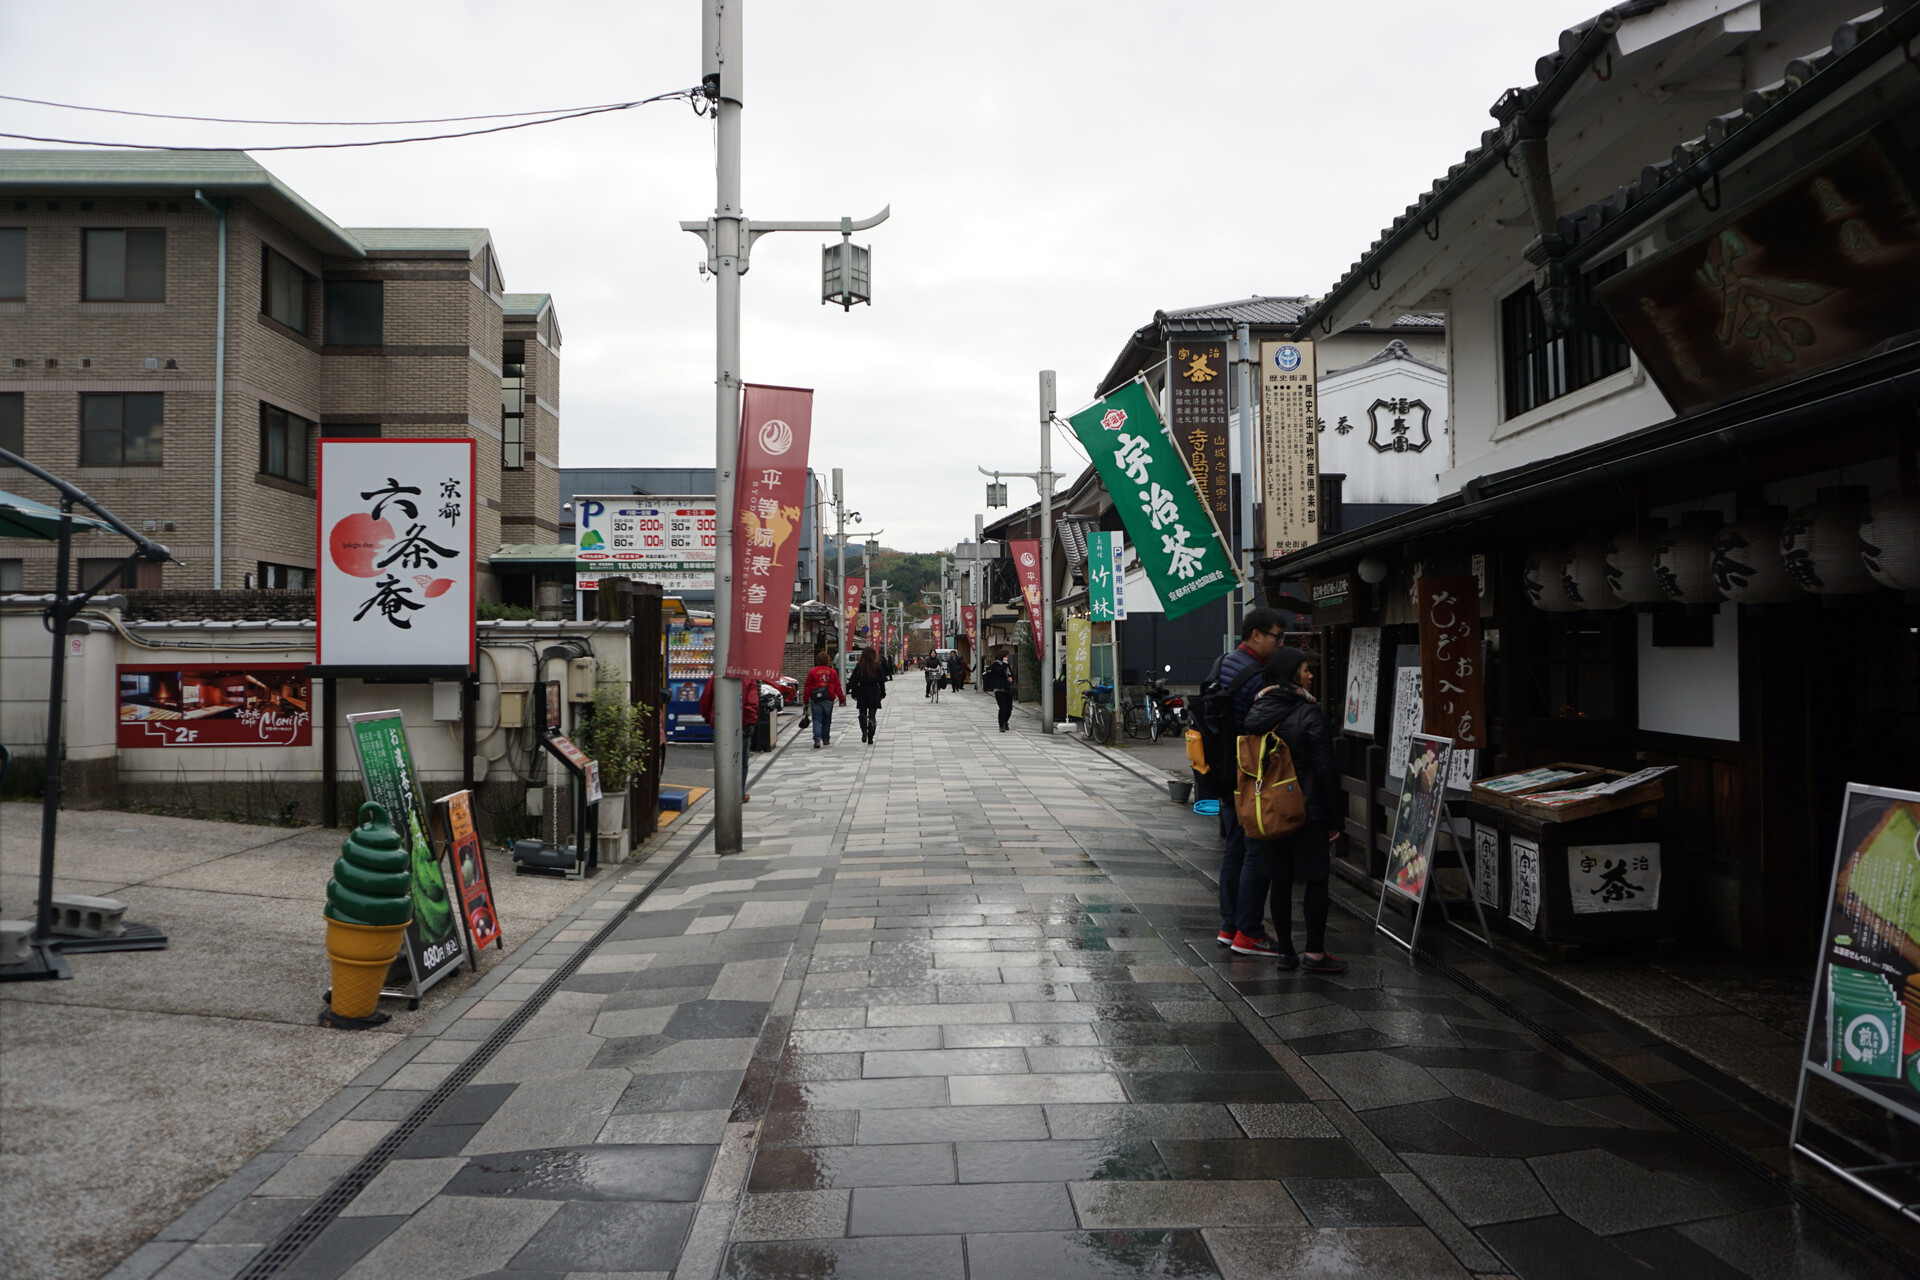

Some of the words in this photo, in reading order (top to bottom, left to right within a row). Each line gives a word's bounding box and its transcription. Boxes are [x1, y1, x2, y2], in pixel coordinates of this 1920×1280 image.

[1269, 374, 1308, 382] 歴史街道
[438, 478, 461, 527] 京都
[580, 500, 605, 528] P
[1113, 433, 1207, 580] 宇治茶
[353, 478, 460, 629] 六条庵
[744, 469, 783, 634] 平等院表参道
[1114, 547, 1122, 557] P
[1091, 564, 1115, 618] 竹林
[1115, 564, 1124, 617] 専用駐車場
[753, 668, 761, 677] To
[765, 669, 780, 680] Uji
[175, 727, 198, 742] 2F
